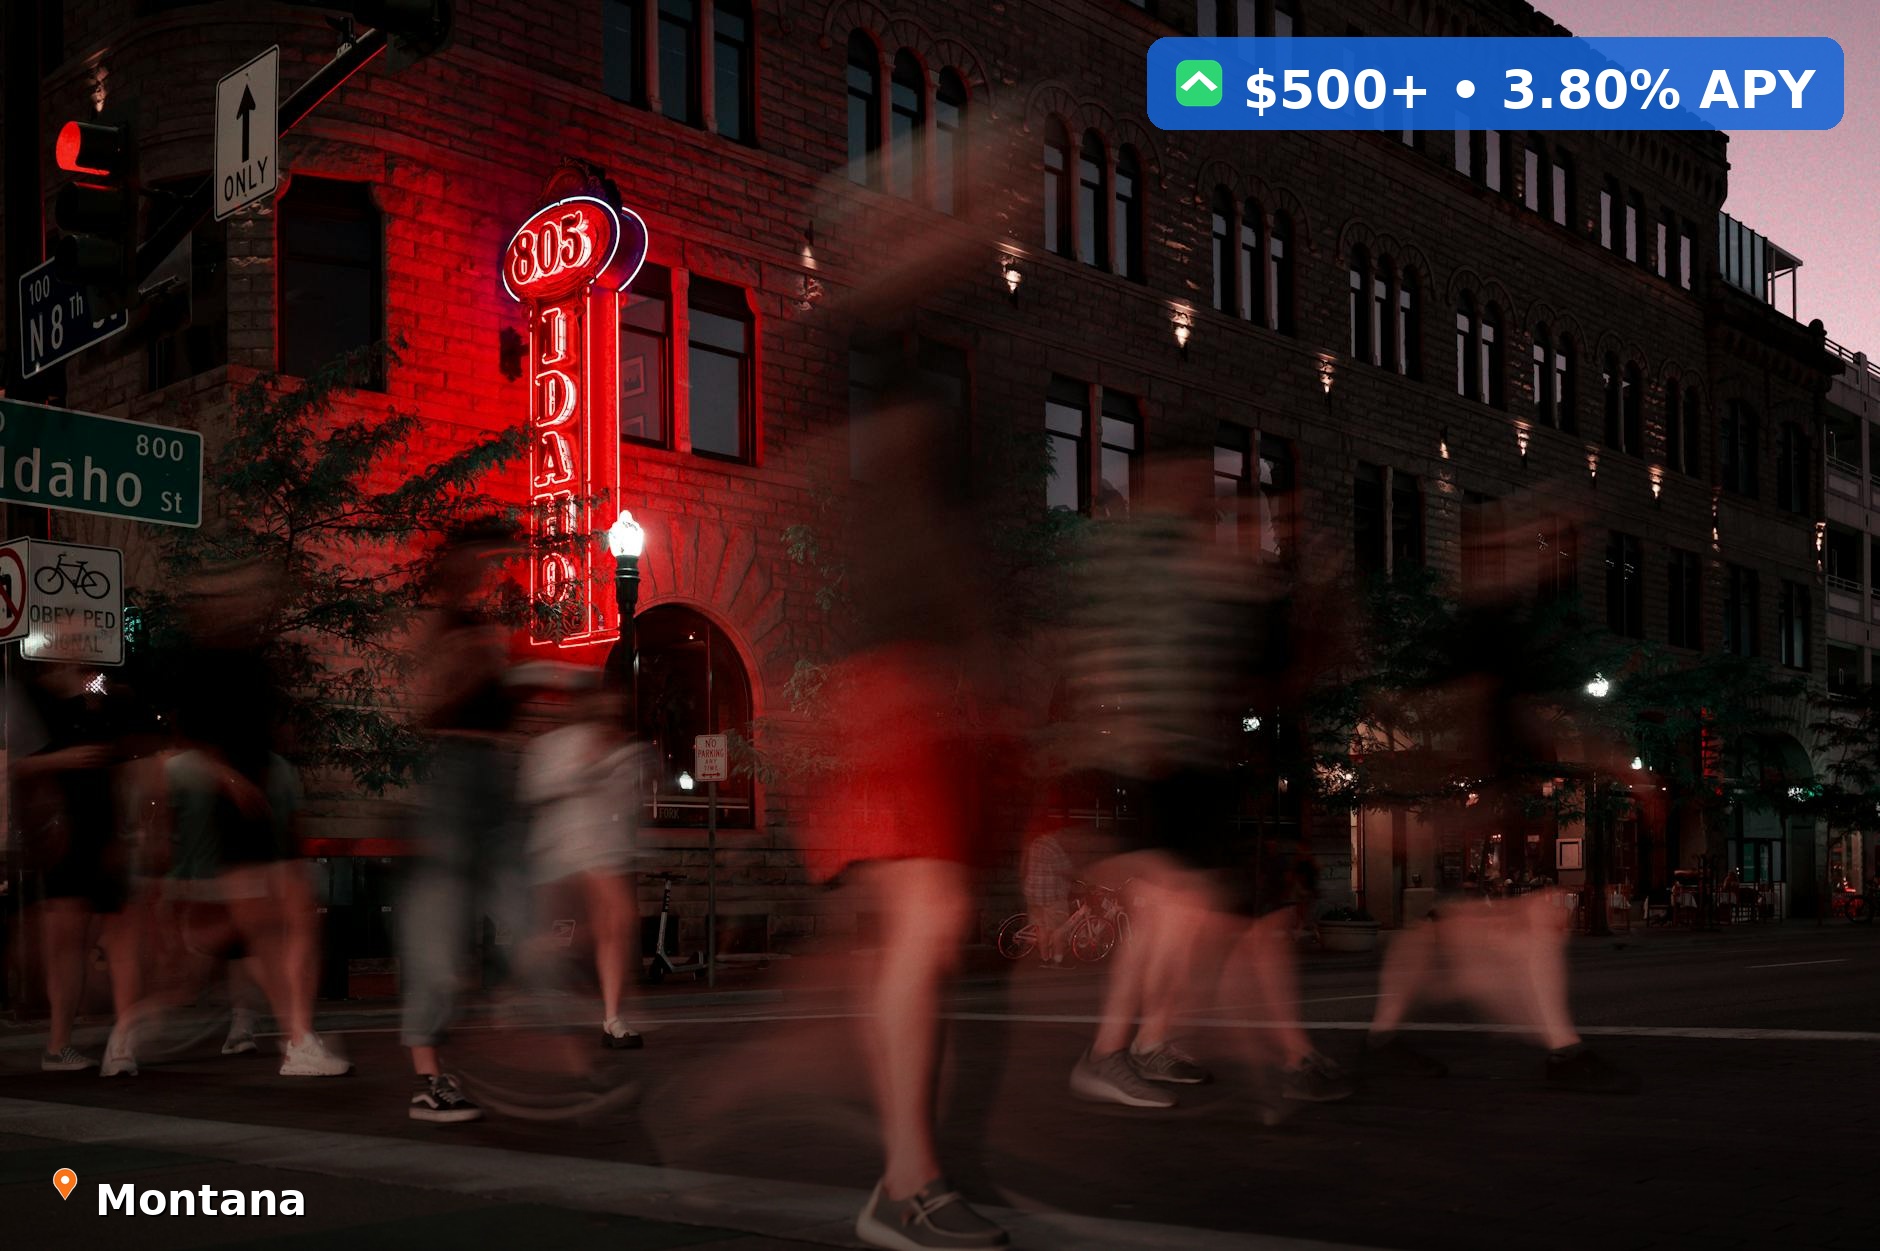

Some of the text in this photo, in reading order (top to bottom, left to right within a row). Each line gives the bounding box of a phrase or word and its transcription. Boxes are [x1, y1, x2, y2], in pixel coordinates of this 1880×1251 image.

[224, 156, 268, 202] ONLY
[512, 210, 592, 285] 805
[30, 274, 50, 305] 100
[30, 311, 44, 362] N
[135, 433, 184, 462] 800
[531, 307, 578, 607] IDAHO
[0, 445, 183, 514] Idaho St
[30, 604, 115, 629] OBEY PED
[697, 748, 725, 758] PARKING
[705, 739, 717, 749] NO
